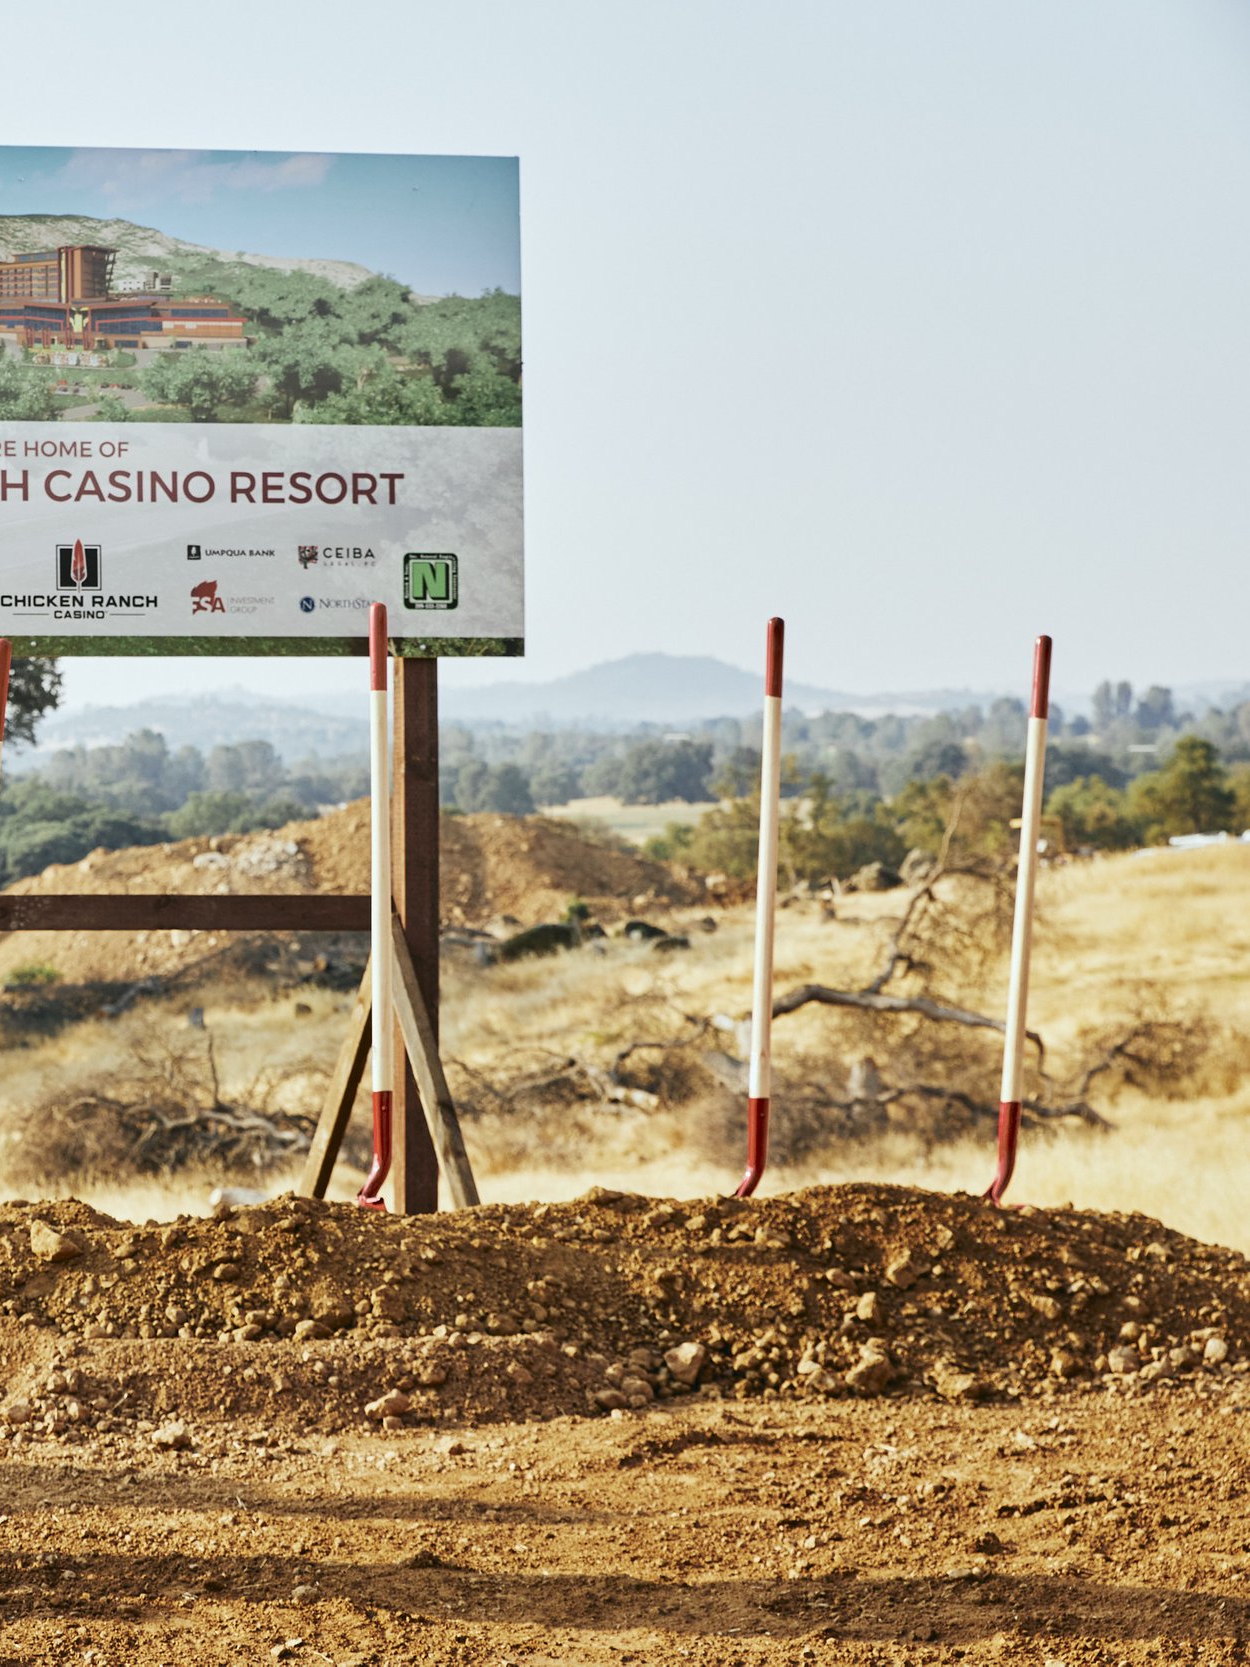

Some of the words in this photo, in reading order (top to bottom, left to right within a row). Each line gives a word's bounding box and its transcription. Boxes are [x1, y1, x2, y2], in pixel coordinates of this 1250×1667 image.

[24, 440, 92, 458] HOME
[99, 440, 129, 458] OF
[44, 469, 216, 503] CASINO
[230, 471, 405, 505] RESORT
[204, 549, 247, 557] UMPQUA
[248, 549, 275, 557] BANK
[322, 547, 375, 559] CEIBA
[412, 561, 450, 600] N
[0, 594, 84, 607] CHICKEN
[92, 595, 158, 608] RANCH
[319, 598, 375, 609] NORTHSTA
[53, 610, 105, 619] CASINO
